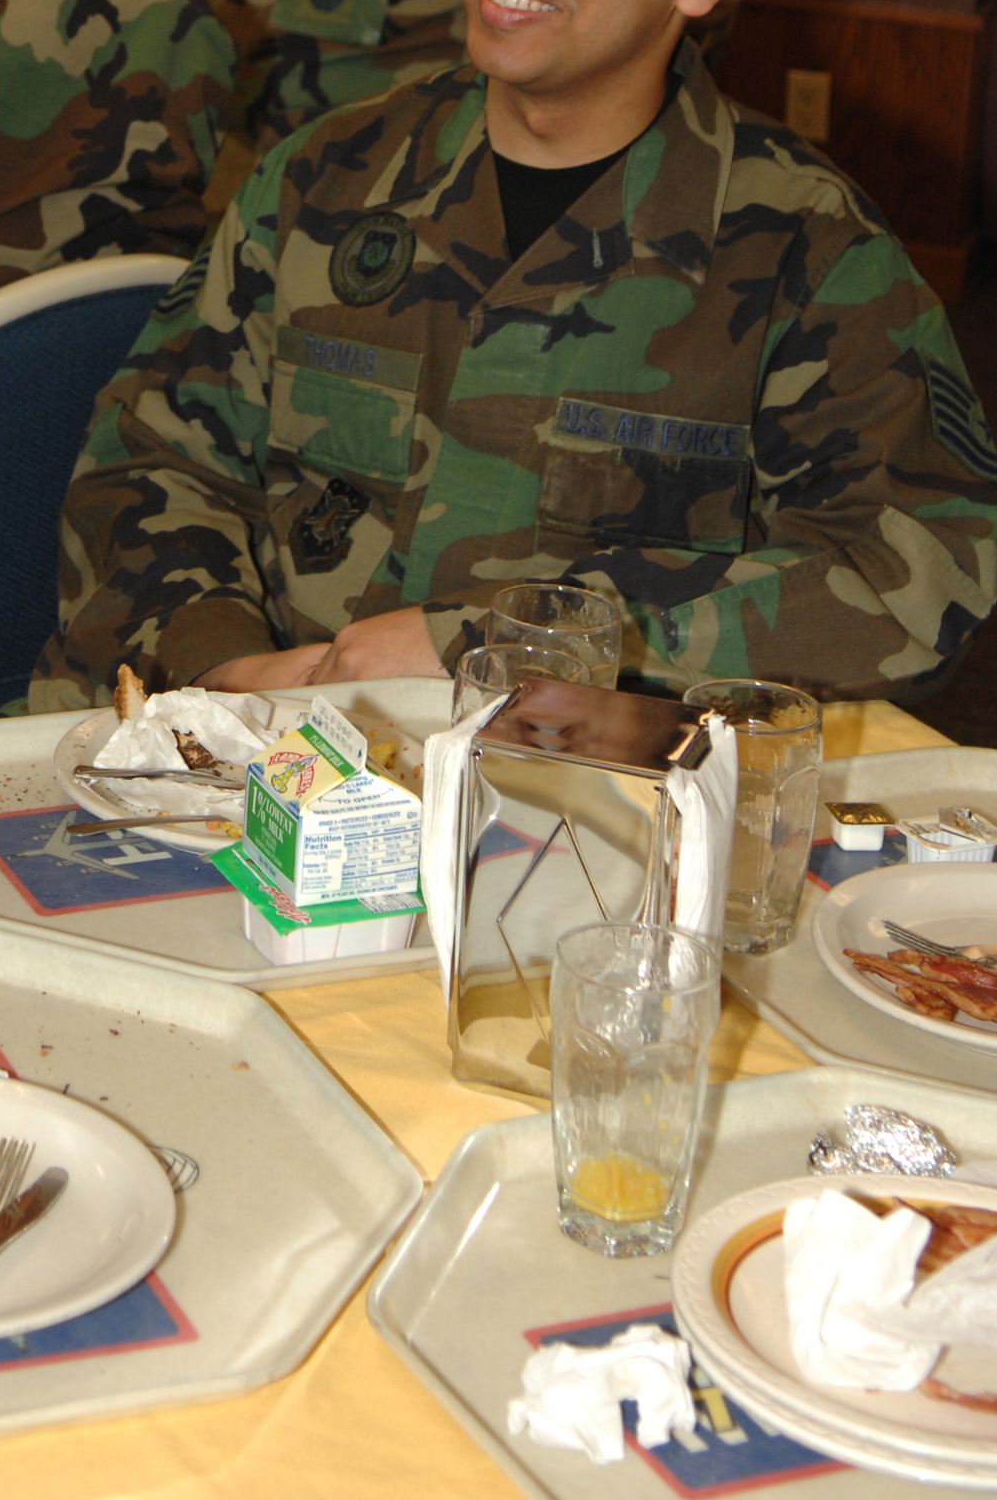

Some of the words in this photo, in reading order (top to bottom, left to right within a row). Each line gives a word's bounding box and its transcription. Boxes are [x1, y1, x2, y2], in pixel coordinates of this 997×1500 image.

[303, 334, 376, 377] THOMAS
[566, 403, 604, 438] U.S.
[613, 413, 654, 447] AIR
[661, 420, 739, 455] FORCE
[274, 752, 299, 762] LAND
[251, 786, 266, 824] 1%
[266, 799, 293, 835] LOWFAT
[353, 794, 380, 803] OPEN
[269, 817, 284, 844] MILK
[305, 835, 342, 843] Nutrition
